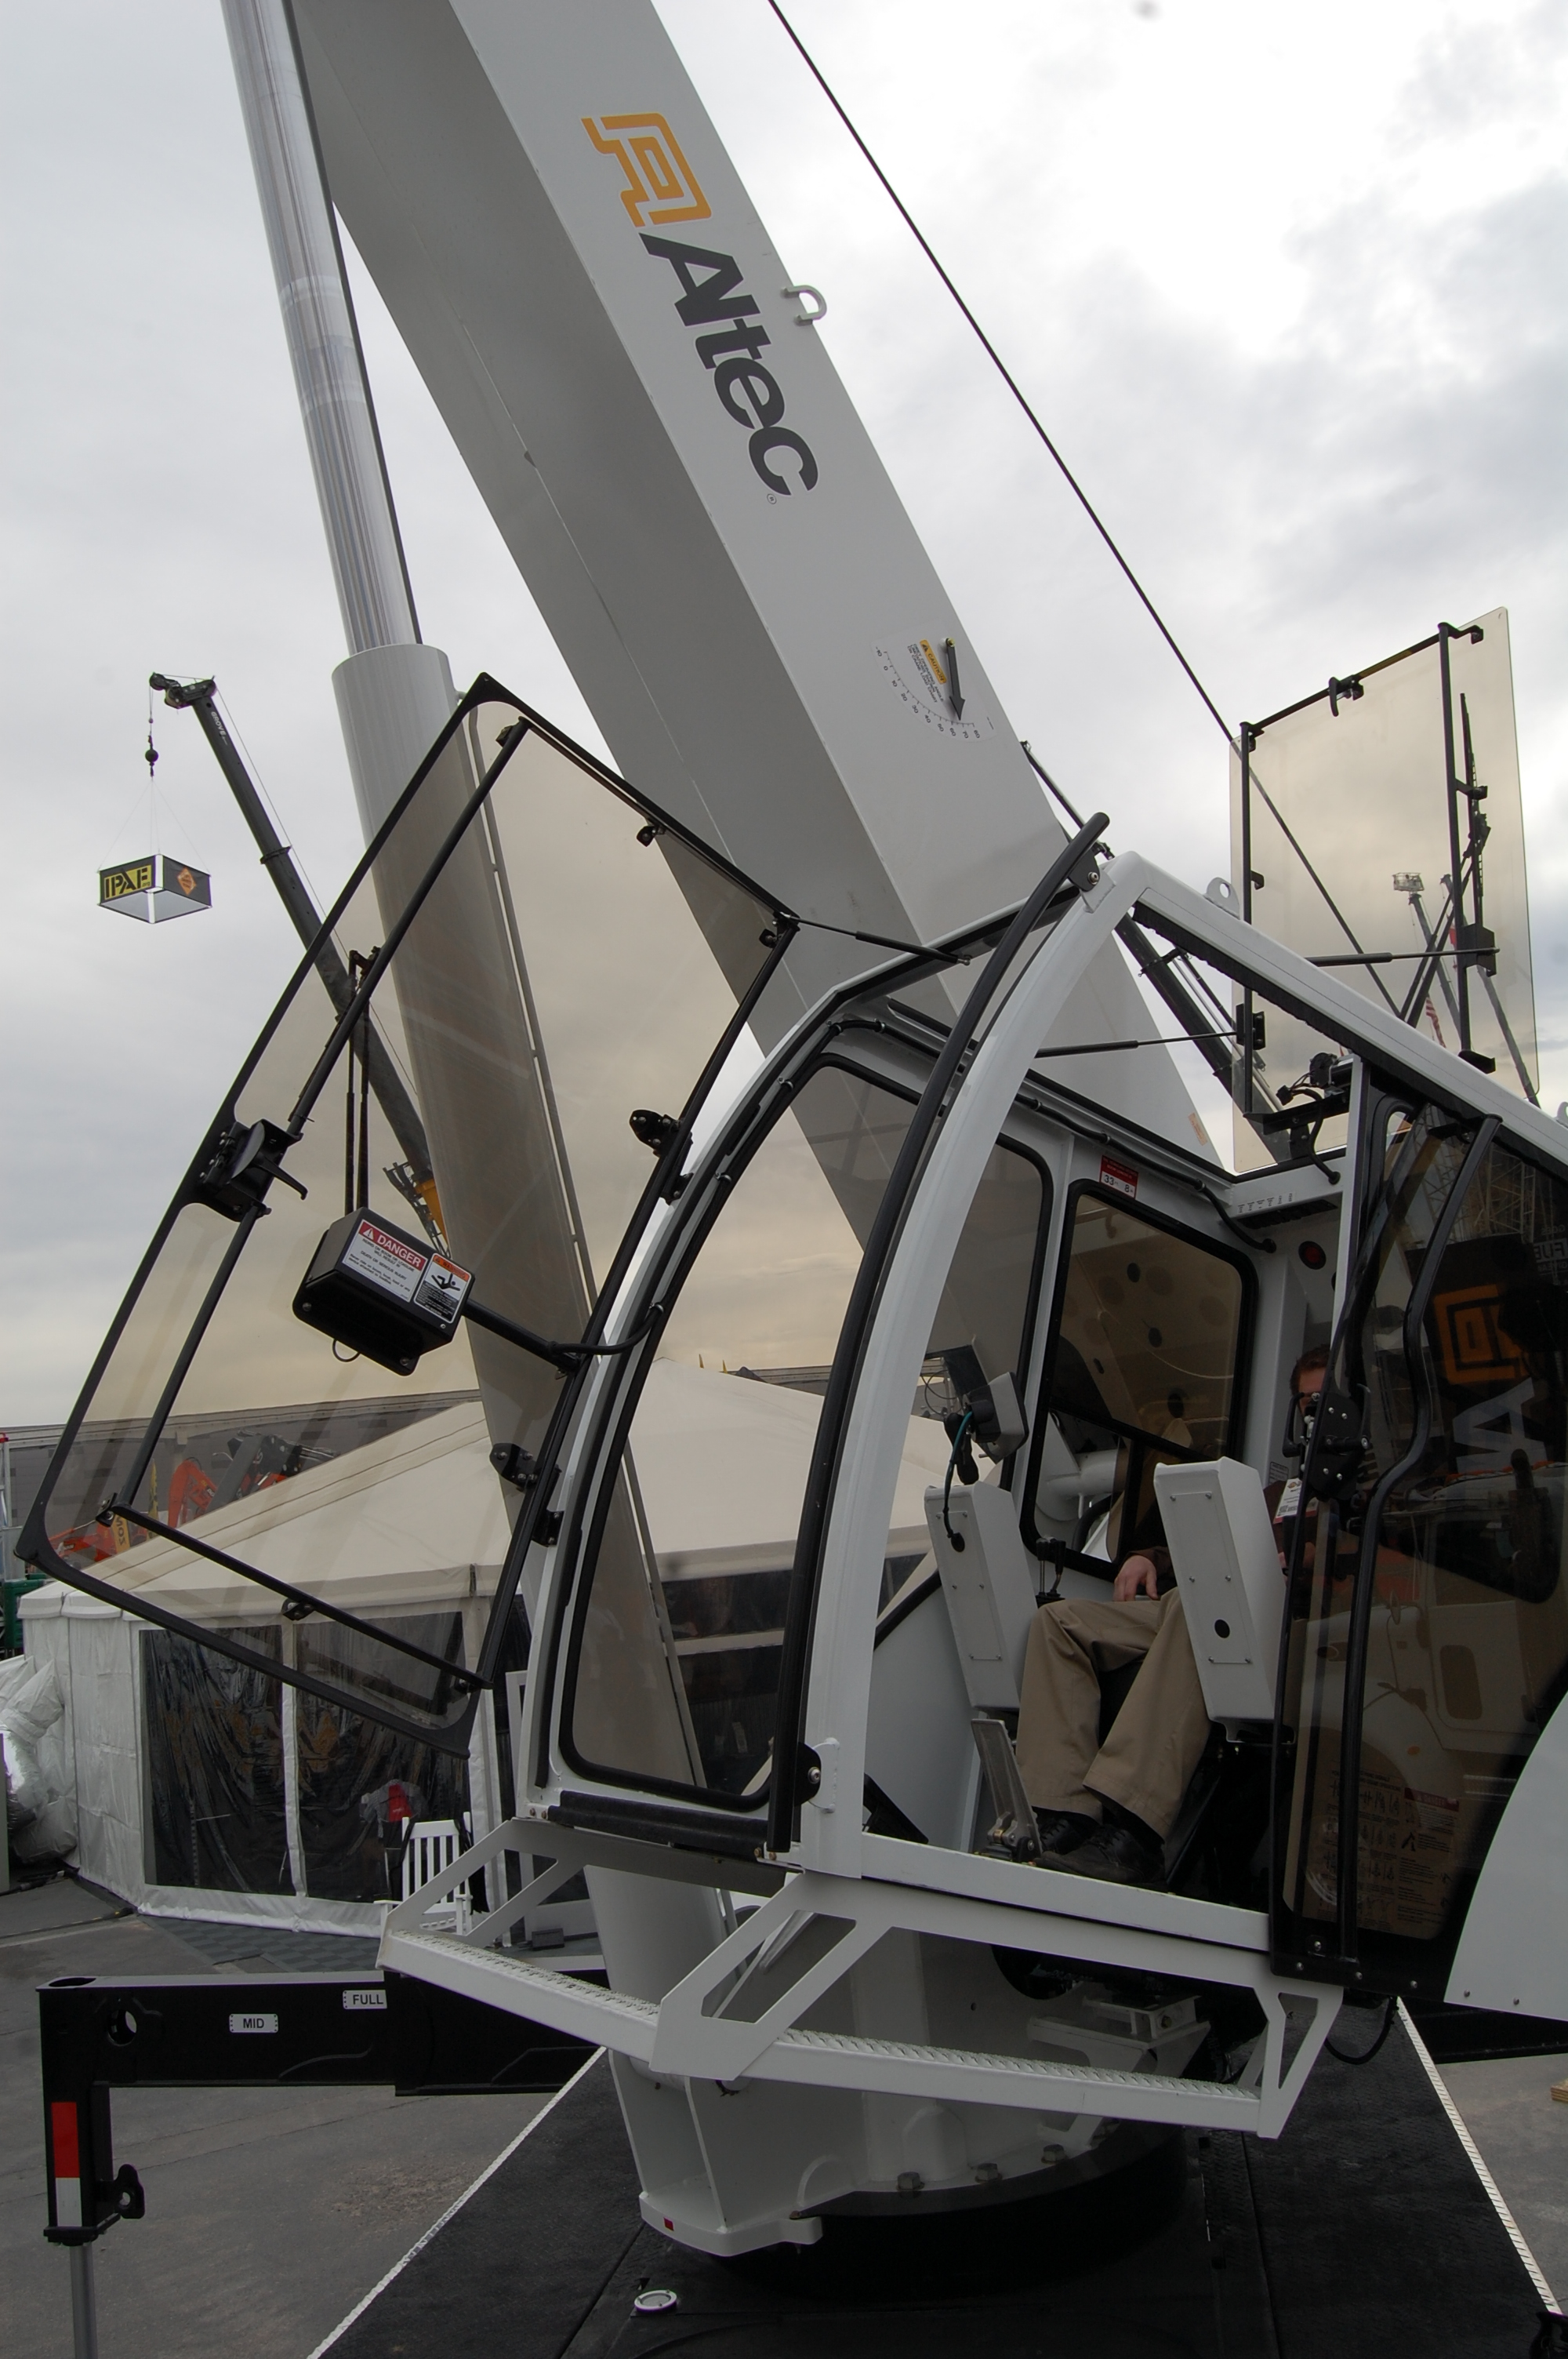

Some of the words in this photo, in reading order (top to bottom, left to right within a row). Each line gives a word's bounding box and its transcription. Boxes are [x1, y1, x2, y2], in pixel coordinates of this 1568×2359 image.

[639, 233, 819, 496] Altec
[927, 652, 944, 681] CAUTION
[927, 686, 937, 703] CHART
[934, 685, 944, 702] ANGLE
[912, 705, 918, 714] 30
[211, 711, 227, 736] GROVE
[949, 728, 956, 736] 60
[974, 730, 980, 739] 80
[106, 867, 147, 898] IPAF
[1104, 1175, 1114, 1186] 33
[1124, 1184, 1130, 1193] 8
[376, 1234, 423, 1267] DANGER
[360, 1250, 372, 1259] DEATH
[378, 1261, 394, 1272] SERIOUS
[394, 1270, 406, 1280] INJURY
[441, 1261, 466, 1278] WARNING
[353, 1994, 383, 2005] FULL
[243, 2019, 264, 2029] MID
